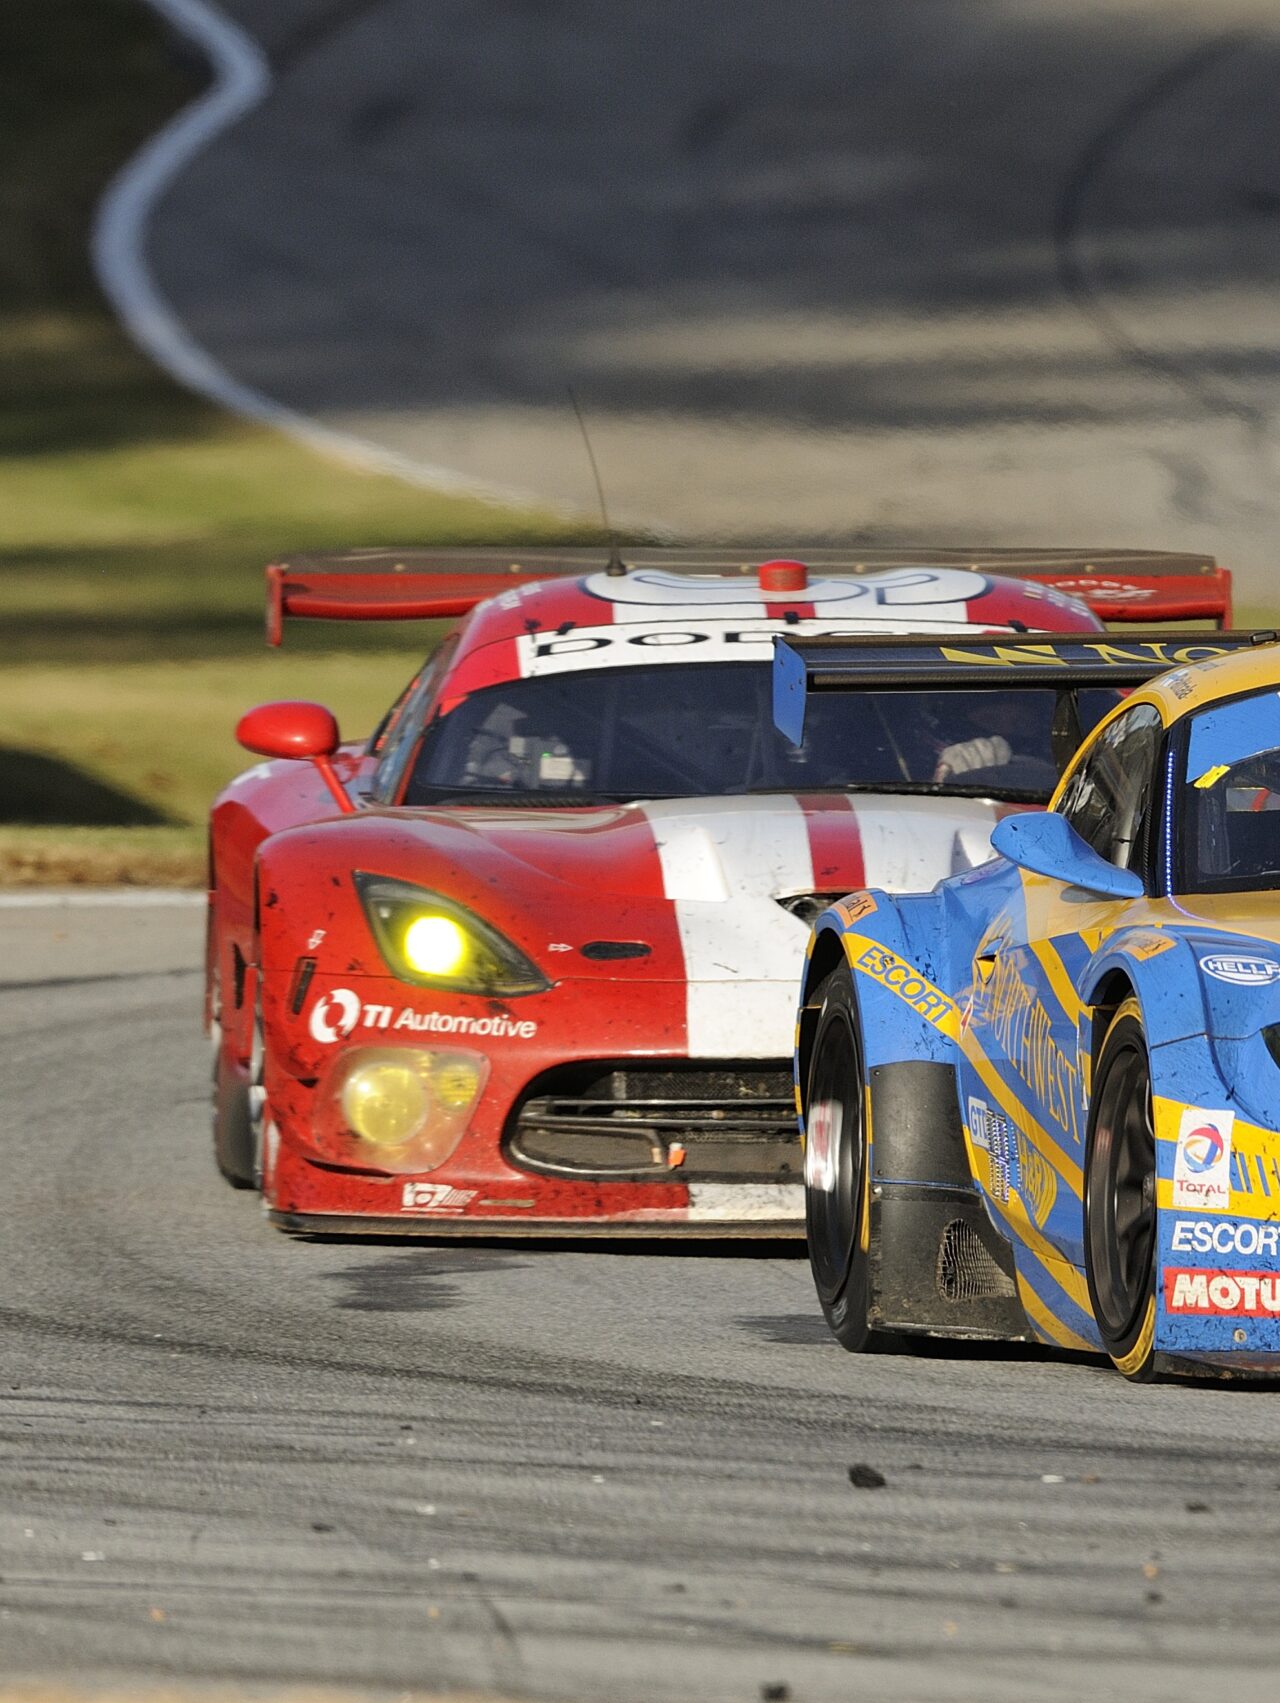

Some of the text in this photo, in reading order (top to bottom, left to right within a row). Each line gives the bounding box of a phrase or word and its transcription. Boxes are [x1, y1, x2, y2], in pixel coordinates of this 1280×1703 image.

[857, 946, 953, 1023] ESCORT
[362, 1003, 538, 1039] TI Automotive
[1176, 1179, 1227, 1195] TOTAL
